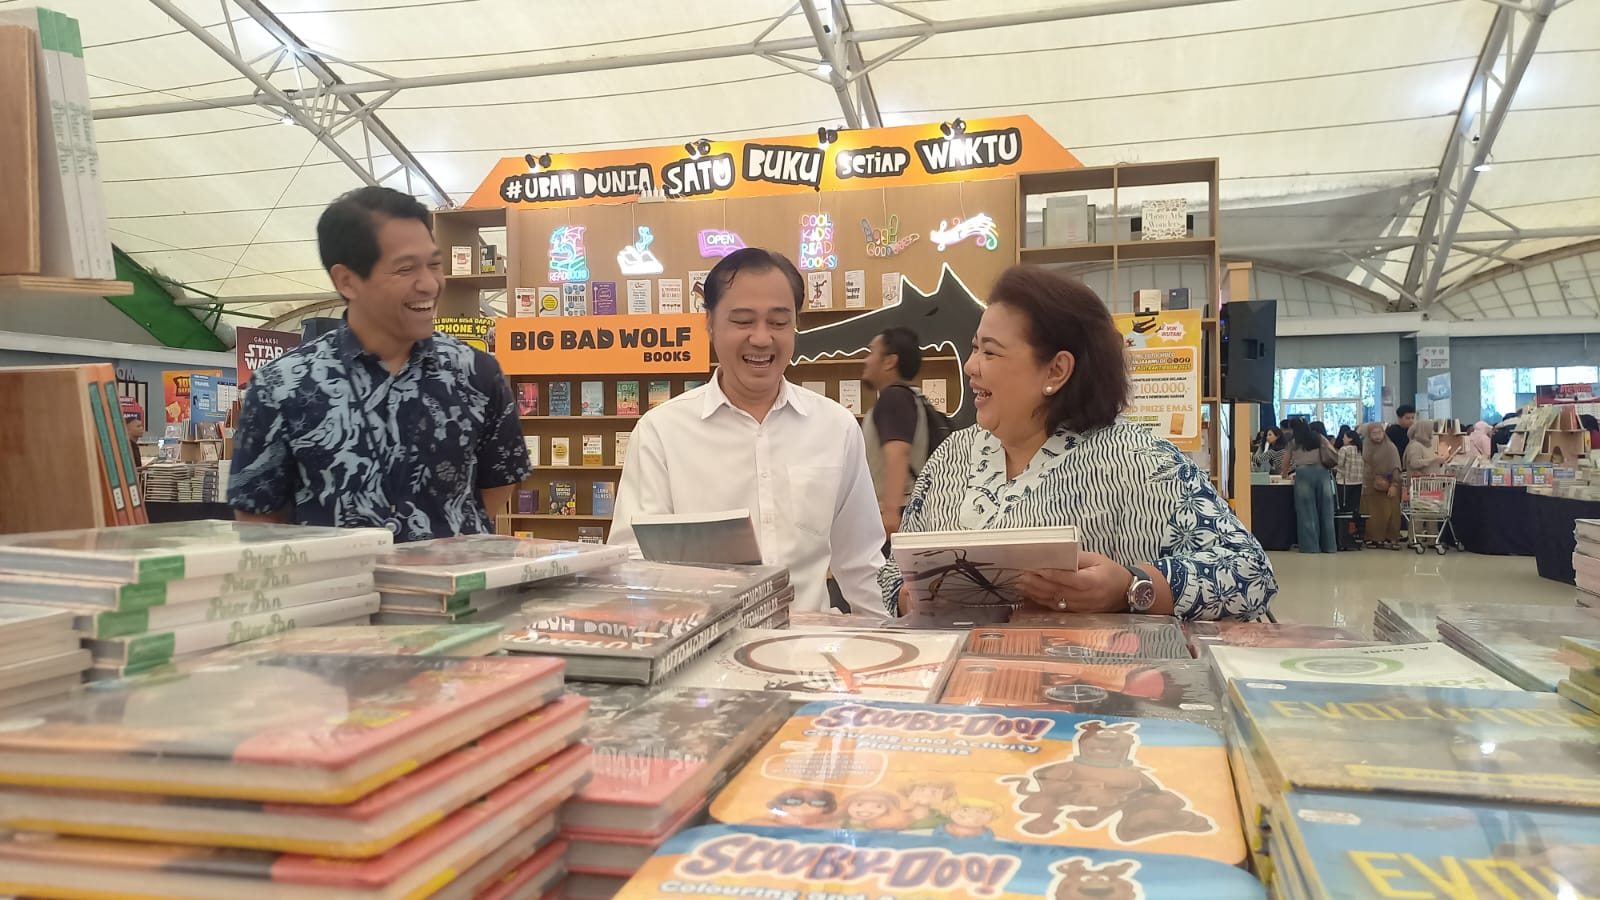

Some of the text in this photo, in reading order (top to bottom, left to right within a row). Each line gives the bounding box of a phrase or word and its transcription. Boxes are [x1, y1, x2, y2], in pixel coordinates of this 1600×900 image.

[506, 174, 576, 199] #UBAH
[583, 168, 653, 194] DUNIA
[666, 157, 732, 195] SATU
[748, 148, 822, 183] BUKU
[922, 131, 1017, 171] WAKTU
[801, 214, 832, 226] COOL
[706, 234, 735, 245] OPEN
[801, 241, 833, 255] READ
[800, 254, 837, 269] BOOKS
[434, 324, 488, 334] IPHONE 16
[510, 327, 691, 351] BIG BAD WOLF
[244, 344, 284, 359] STAR
[643, 350, 691, 362] BOOKS
[238, 543, 308, 570] Peter Pan
[655, 622, 719, 681] AUTOMOBILES
[813, 704, 1053, 742] SCOOBY-DOO!
[803, 729, 1041, 754] Colouring and Activity
[856, 739, 972, 756] Placemats
[679, 833, 1019, 897] SCOOBY-DOO!
